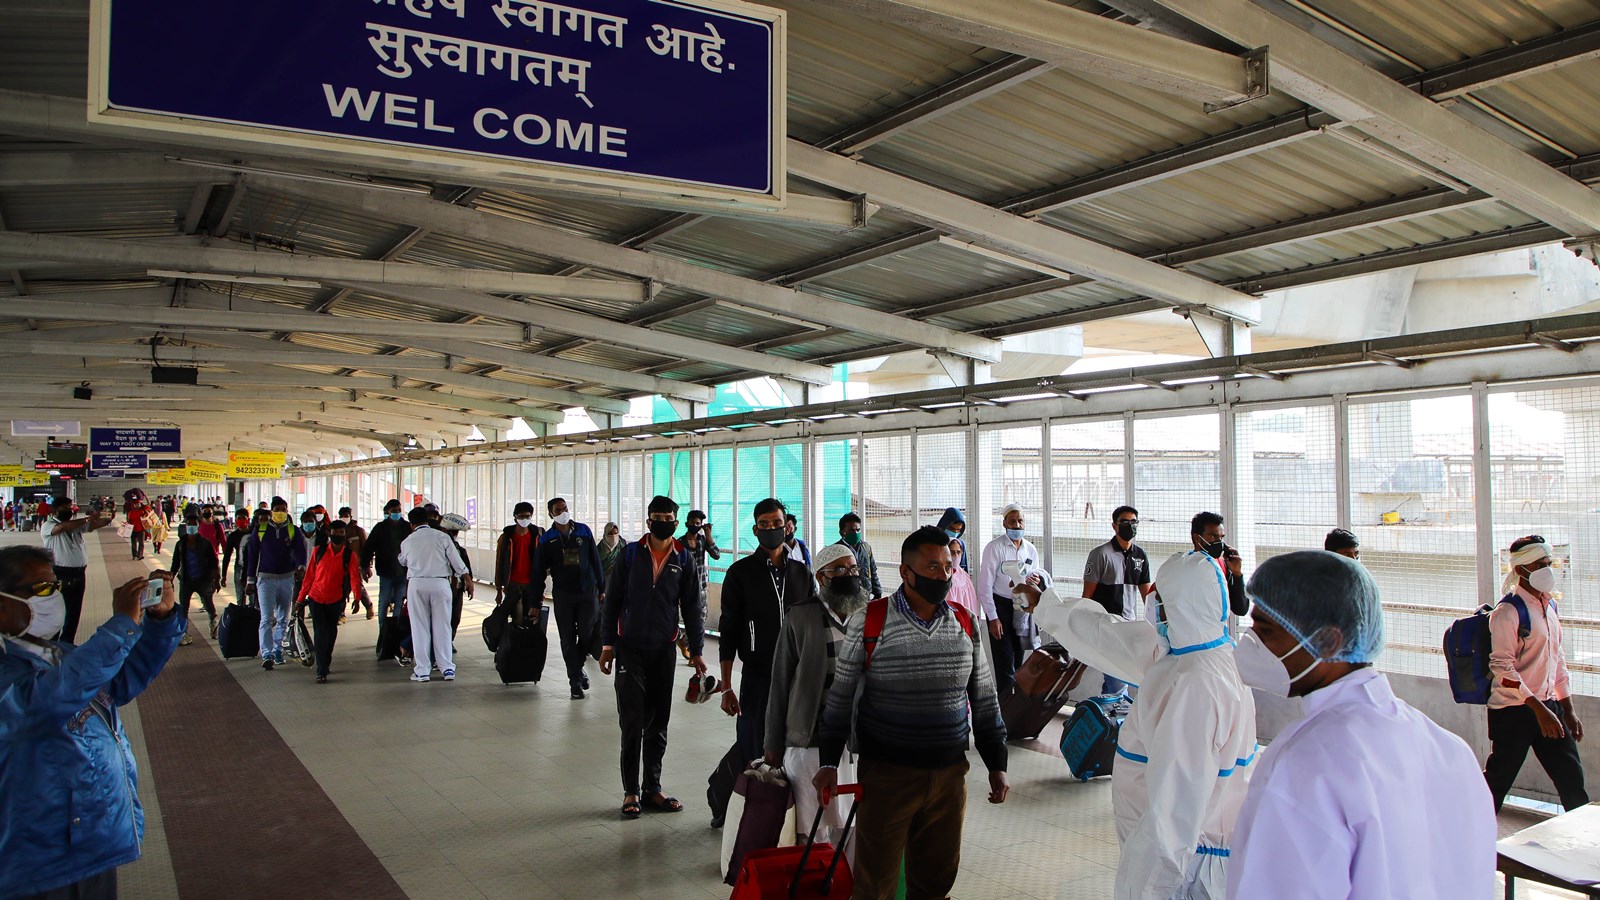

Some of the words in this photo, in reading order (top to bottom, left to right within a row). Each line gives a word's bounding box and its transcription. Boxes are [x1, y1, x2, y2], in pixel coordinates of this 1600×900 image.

[365, 22, 594, 108] सुस्वागतम्
[491, 0, 628, 49] स्वागत
[645, 22, 736, 73] आहे.
[322, 83, 455, 134] WEL
[473, 107, 628, 158] COME
[190, 470, 221, 480] 9423233791
[235, 466, 278, 475] 9423233791
